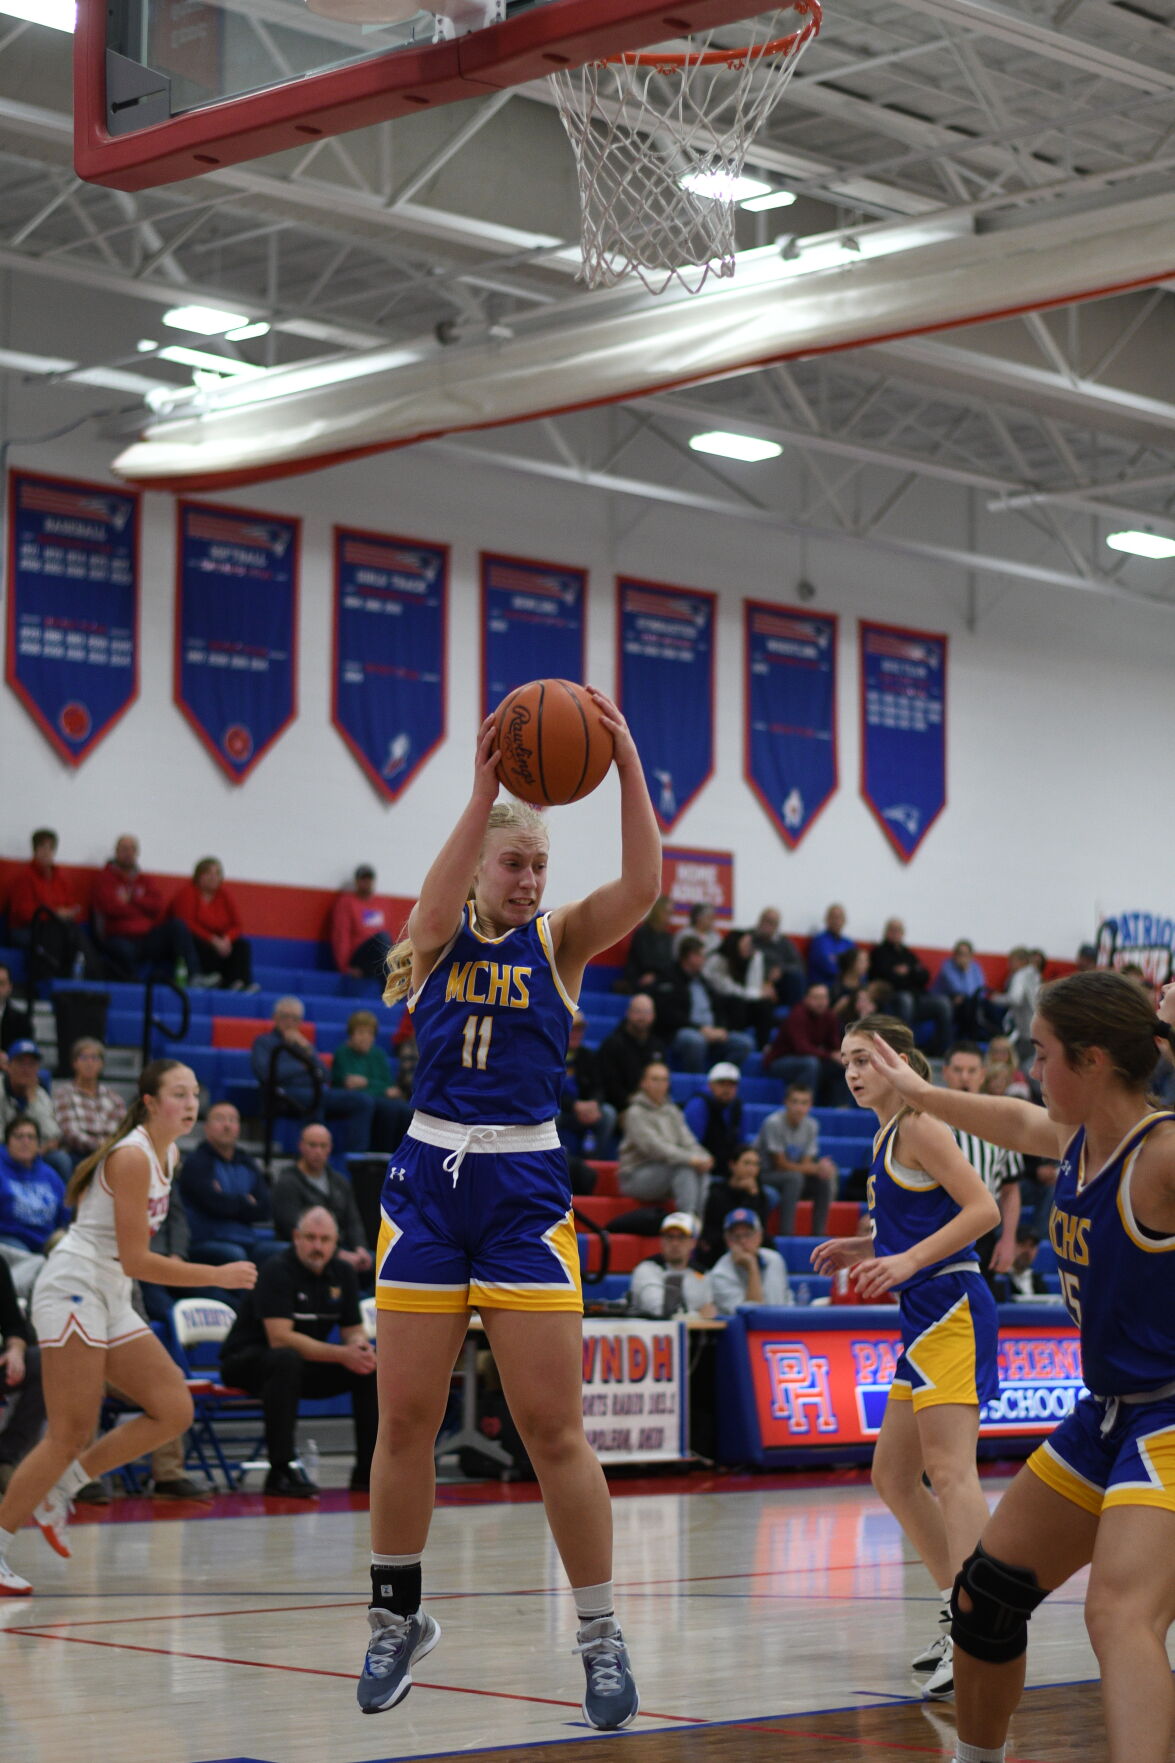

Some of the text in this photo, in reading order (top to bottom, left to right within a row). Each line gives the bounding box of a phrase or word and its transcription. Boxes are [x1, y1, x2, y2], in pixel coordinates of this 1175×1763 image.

[509, 704, 536, 785] Rawlings
[445, 960, 532, 1009] MCHS
[462, 1014, 494, 1071] 11
[762, 1340, 839, 1434] PH
